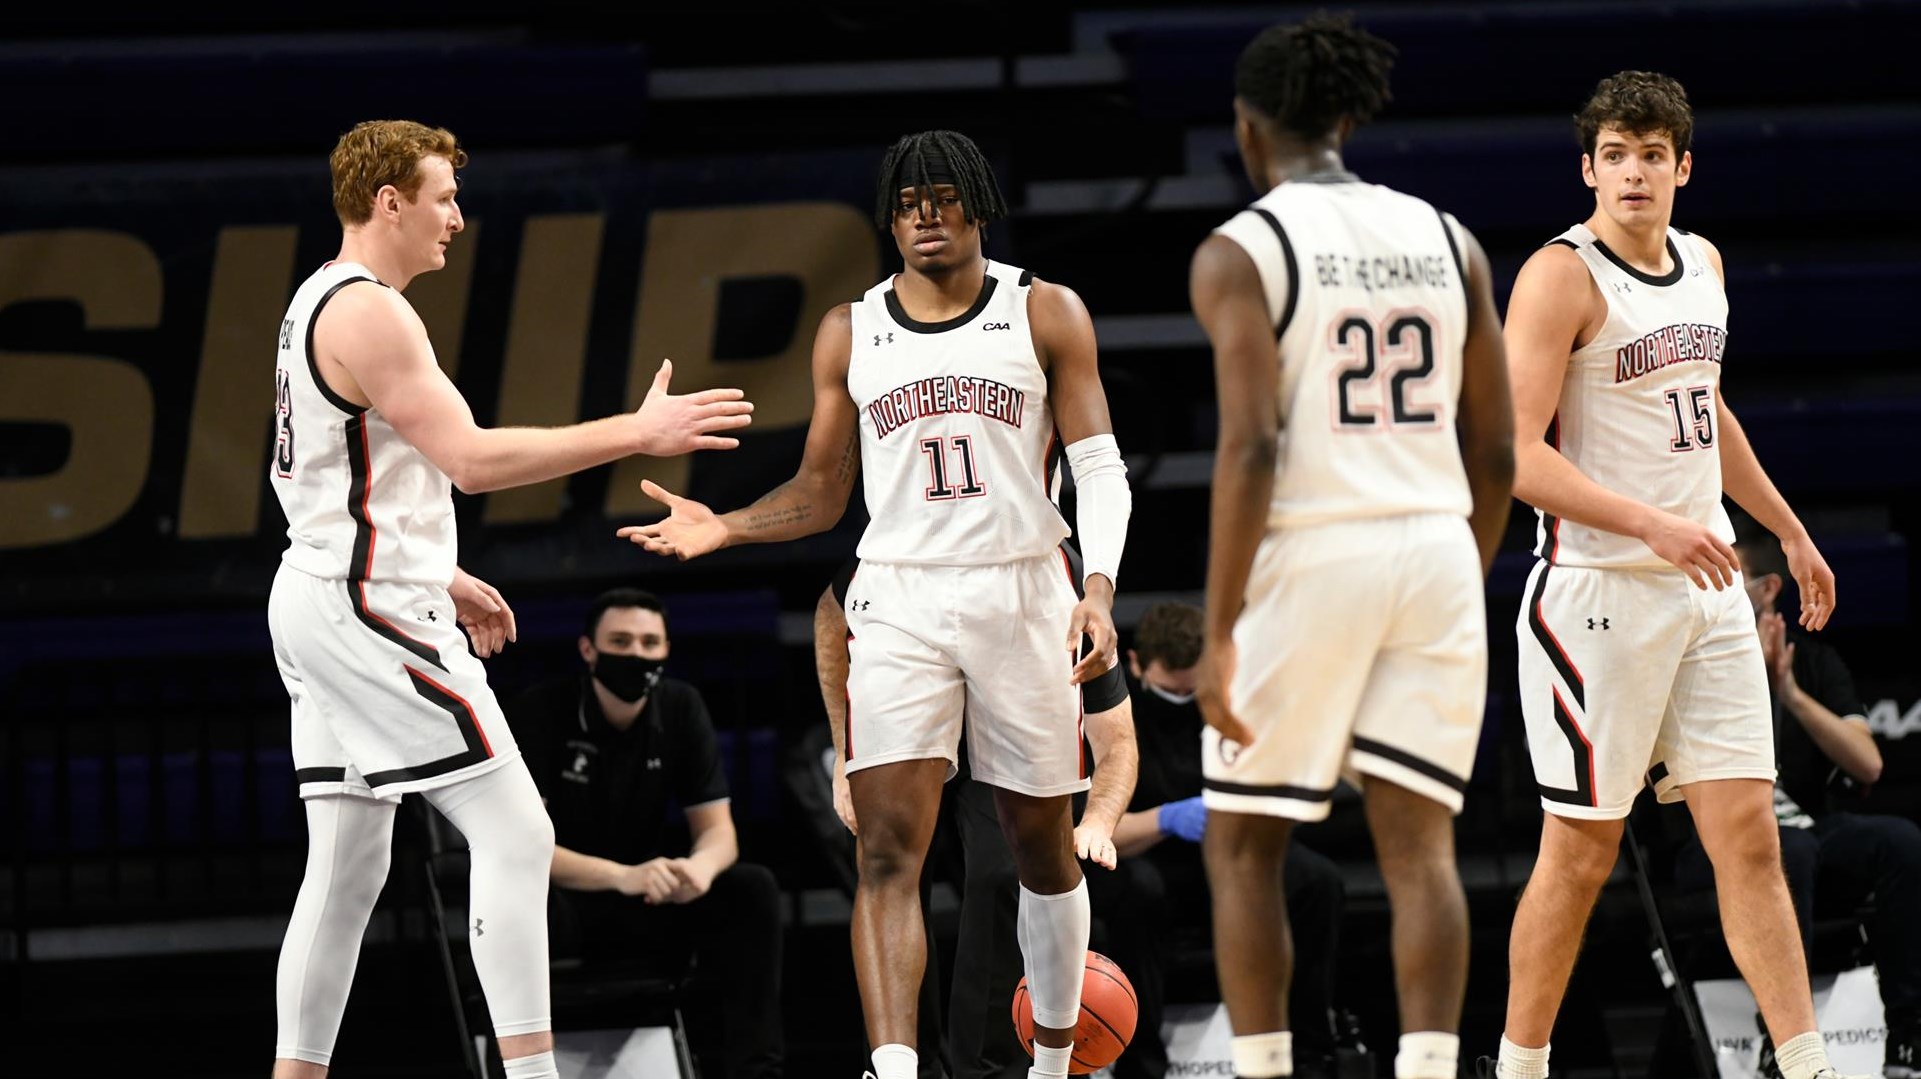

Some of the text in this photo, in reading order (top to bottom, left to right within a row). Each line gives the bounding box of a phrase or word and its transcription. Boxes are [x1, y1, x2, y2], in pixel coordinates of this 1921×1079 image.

[1315, 254, 1340, 286] BE
[1373, 255, 1447, 289] CHANGE
[982, 322, 1011, 331] CAA
[1615, 323, 1727, 384] NORTHEASTER
[1327, 306, 1444, 434] 22
[274, 368, 296, 480] 3
[869, 376, 1025, 440] NORTHEASTERN
[1664, 385, 1713, 453] 15
[920, 434, 986, 501] 11
